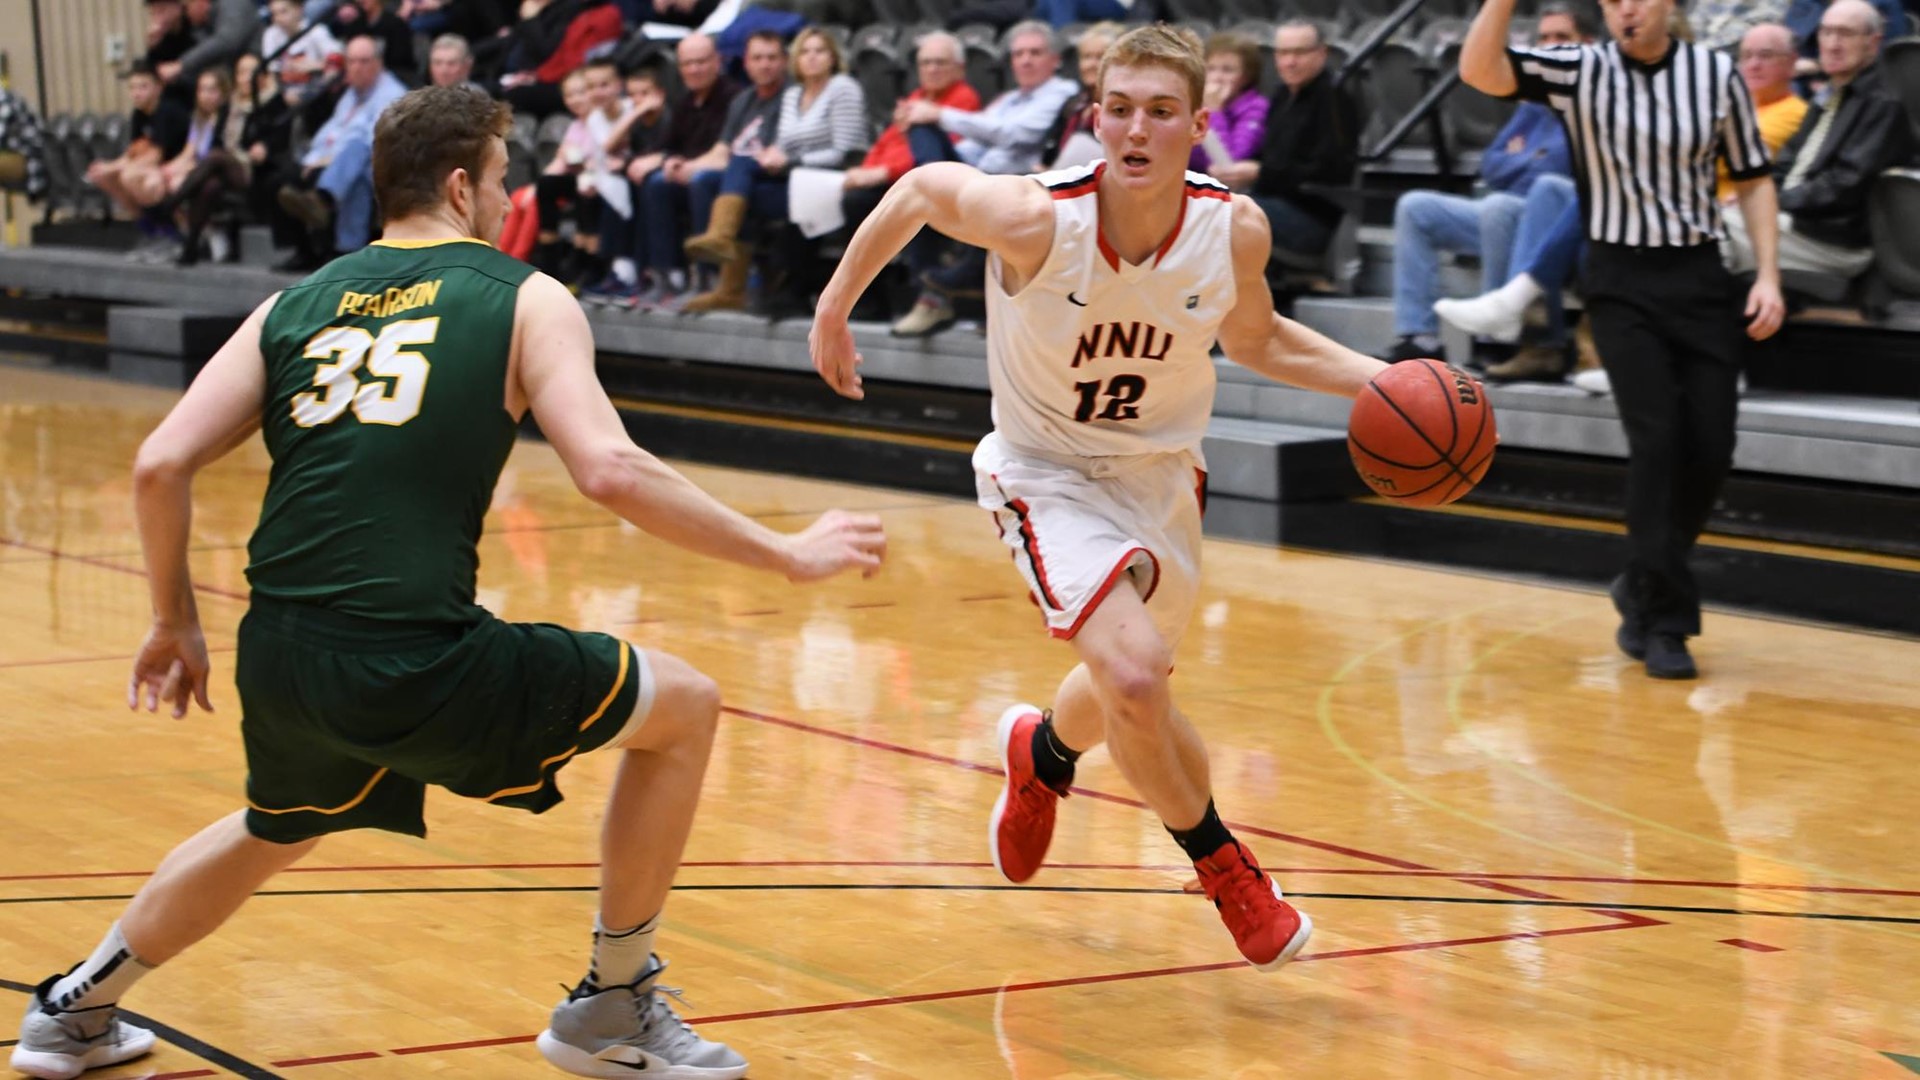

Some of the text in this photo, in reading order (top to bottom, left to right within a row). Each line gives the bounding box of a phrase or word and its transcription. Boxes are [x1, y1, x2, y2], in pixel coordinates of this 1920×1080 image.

[336, 279, 443, 317] PEARSON
[1070, 321, 1174, 368] NNU
[290, 316, 441, 428] 35
[1073, 373, 1147, 423] 12
